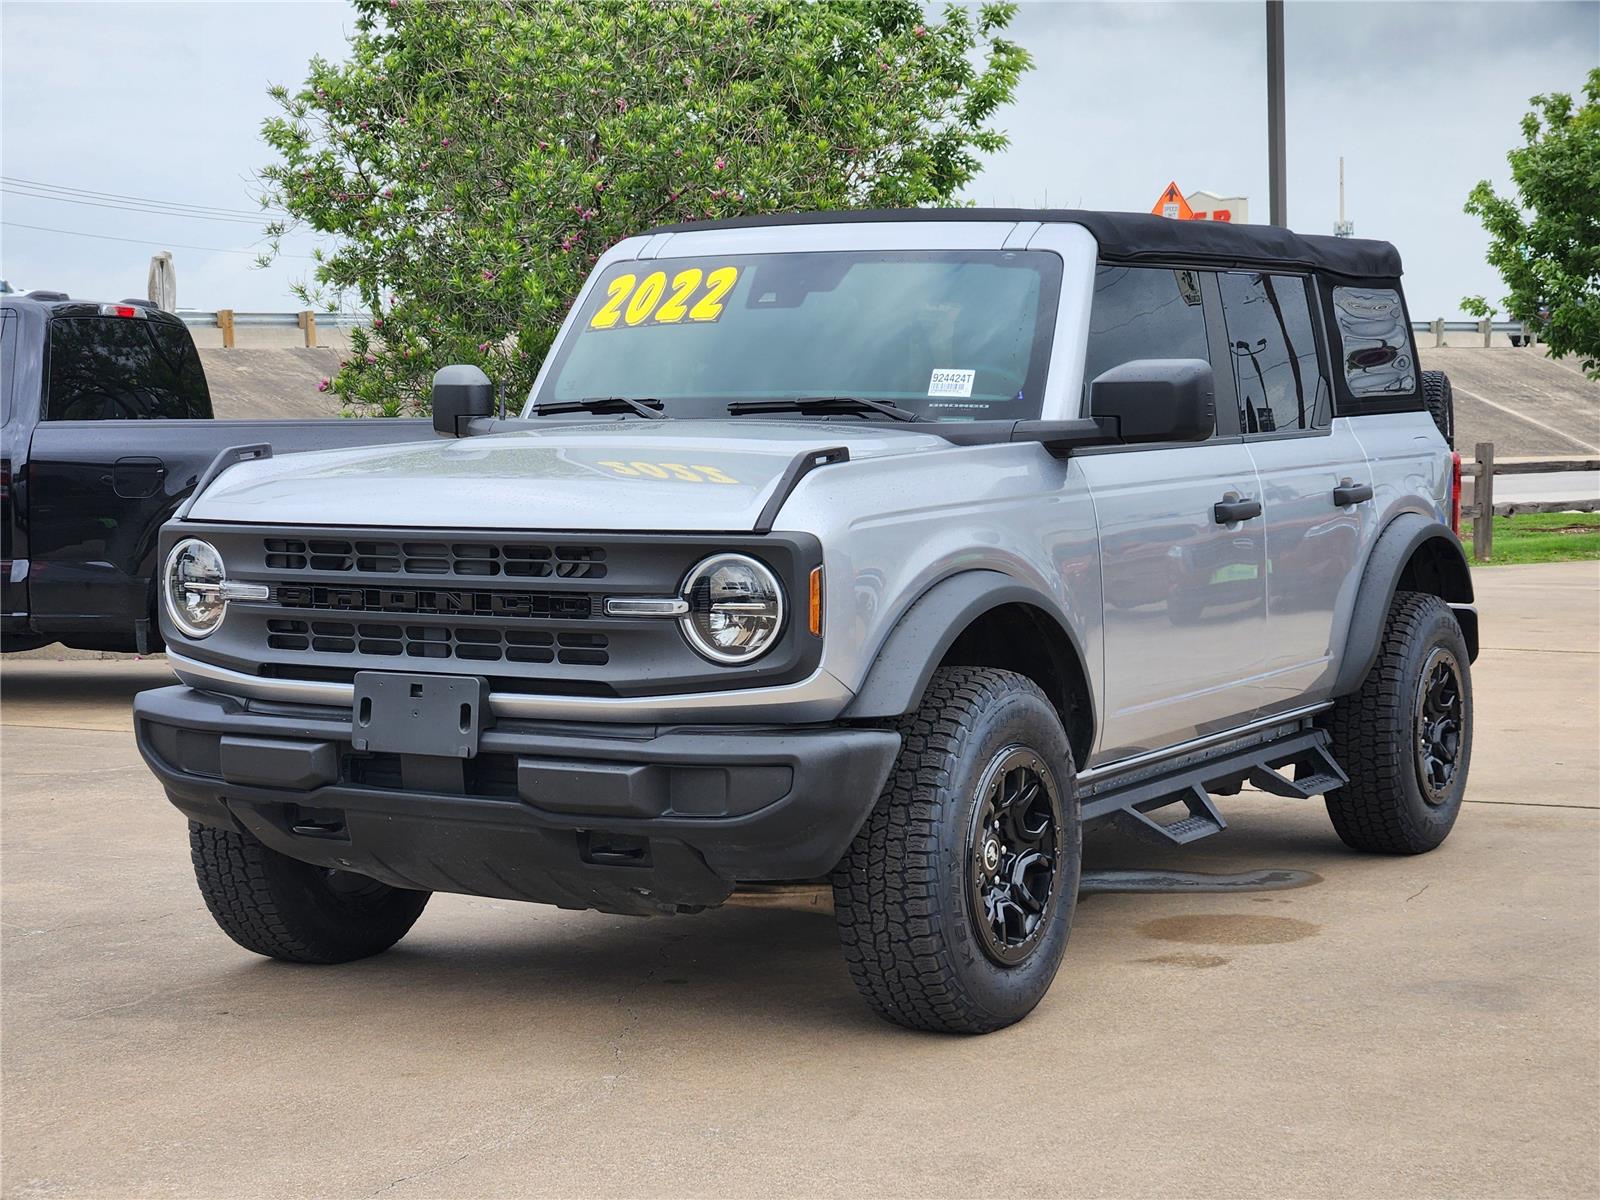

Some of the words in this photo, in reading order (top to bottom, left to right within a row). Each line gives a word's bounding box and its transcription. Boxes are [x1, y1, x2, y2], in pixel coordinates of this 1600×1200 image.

[591, 266, 738, 329] 2022
[932, 373, 973, 384] 924424T
[276, 586, 591, 618] BRONCO
